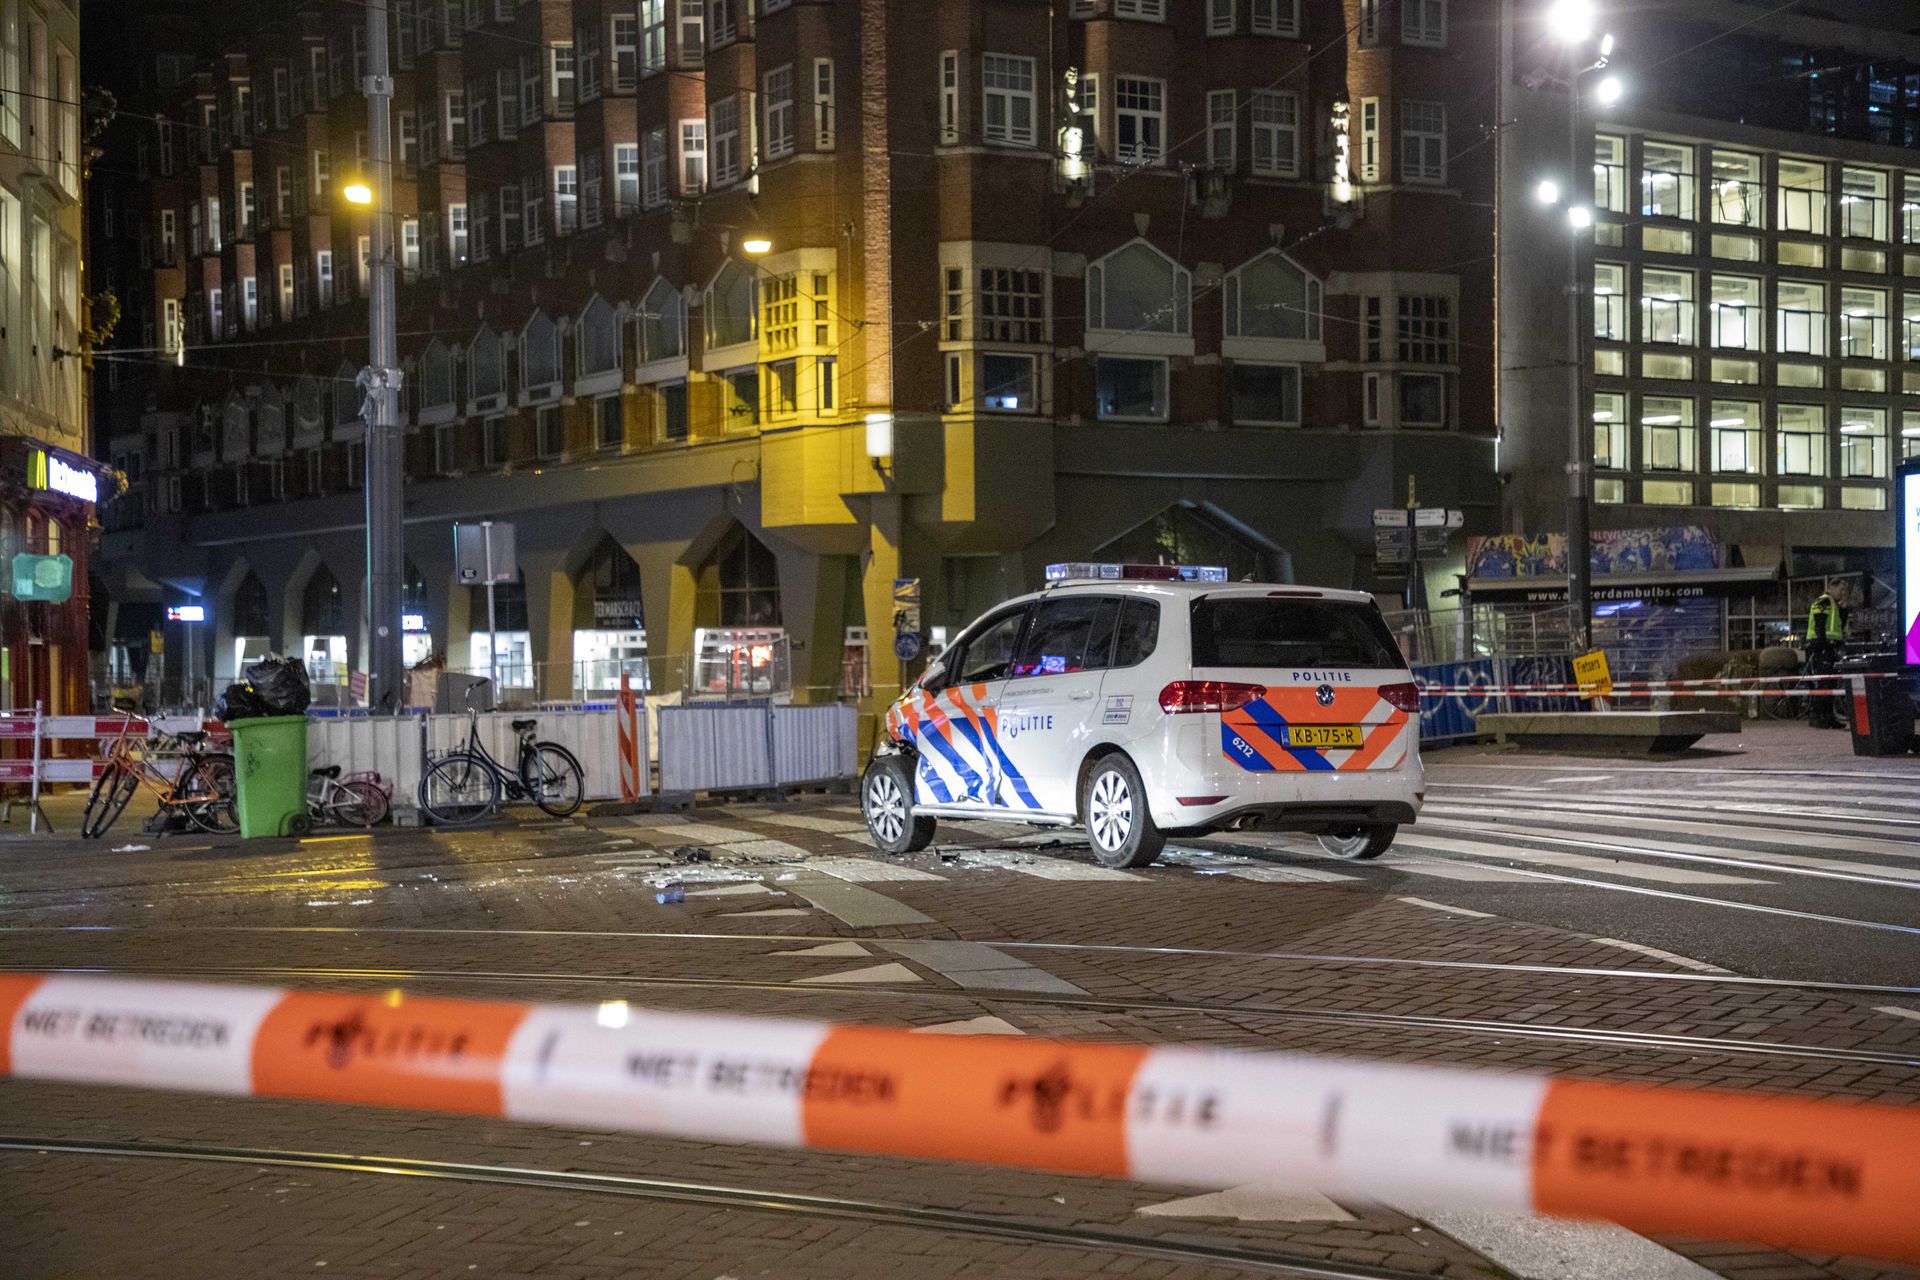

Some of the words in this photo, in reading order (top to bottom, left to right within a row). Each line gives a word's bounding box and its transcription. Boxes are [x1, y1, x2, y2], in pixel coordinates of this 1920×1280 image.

[1527, 586, 1703, 601] www.aerdambulbs.com
[1293, 671, 1352, 682] POLITIE
[1002, 715, 1053, 738] POLITIE
[1294, 728, 1354, 743] KB-175-R
[1232, 736, 1255, 758] 6212
[24, 1007, 81, 1036] NIET
[84, 1011, 229, 1046] BETREDEN
[628, 1050, 695, 1085] NIET
[710, 1057, 897, 1102] BETREDEN
[1448, 1119, 1552, 1164] NIET
[1570, 1129, 1864, 1197] BETREDEN
